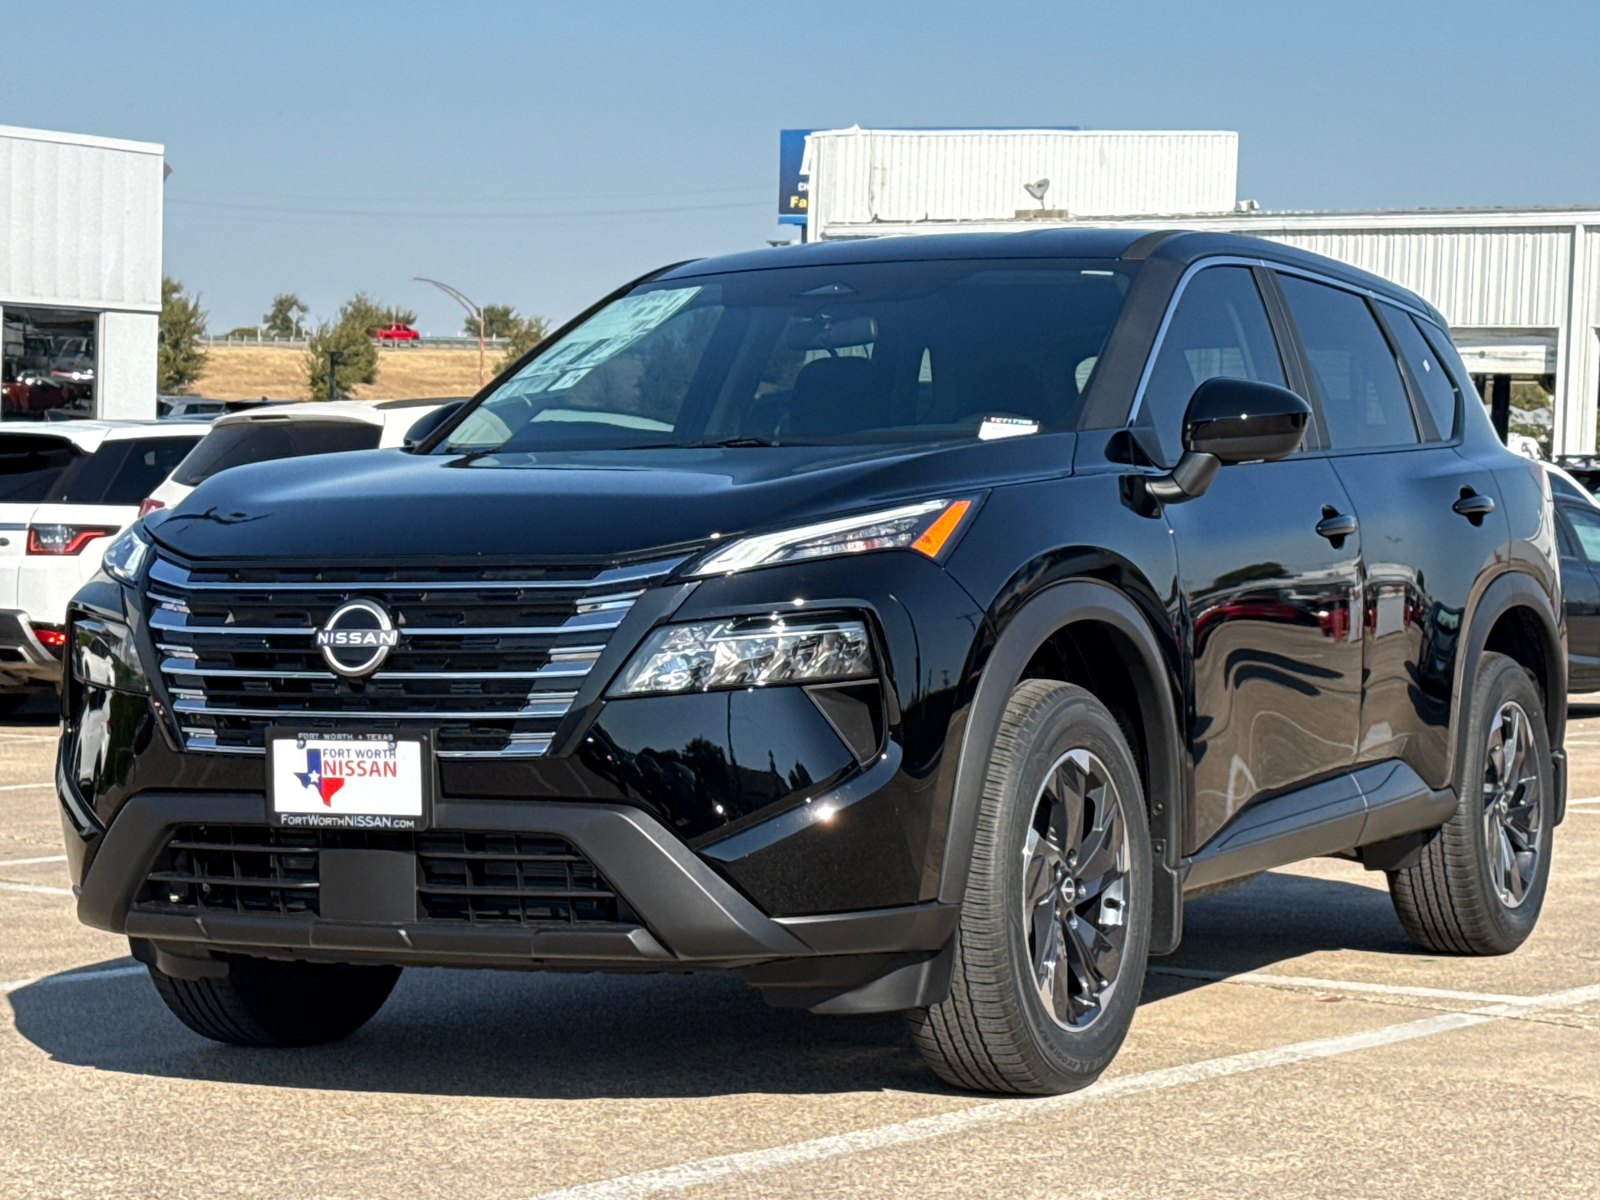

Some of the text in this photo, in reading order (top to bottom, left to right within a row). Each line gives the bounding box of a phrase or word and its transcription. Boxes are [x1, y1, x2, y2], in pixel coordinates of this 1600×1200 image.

[317, 632, 395, 645] NISSAN
[298, 732, 394, 741] FORT WORTH TEXAS
[322, 748, 396, 759] FORT WORTH
[323, 760, 397, 777] NISSAN
